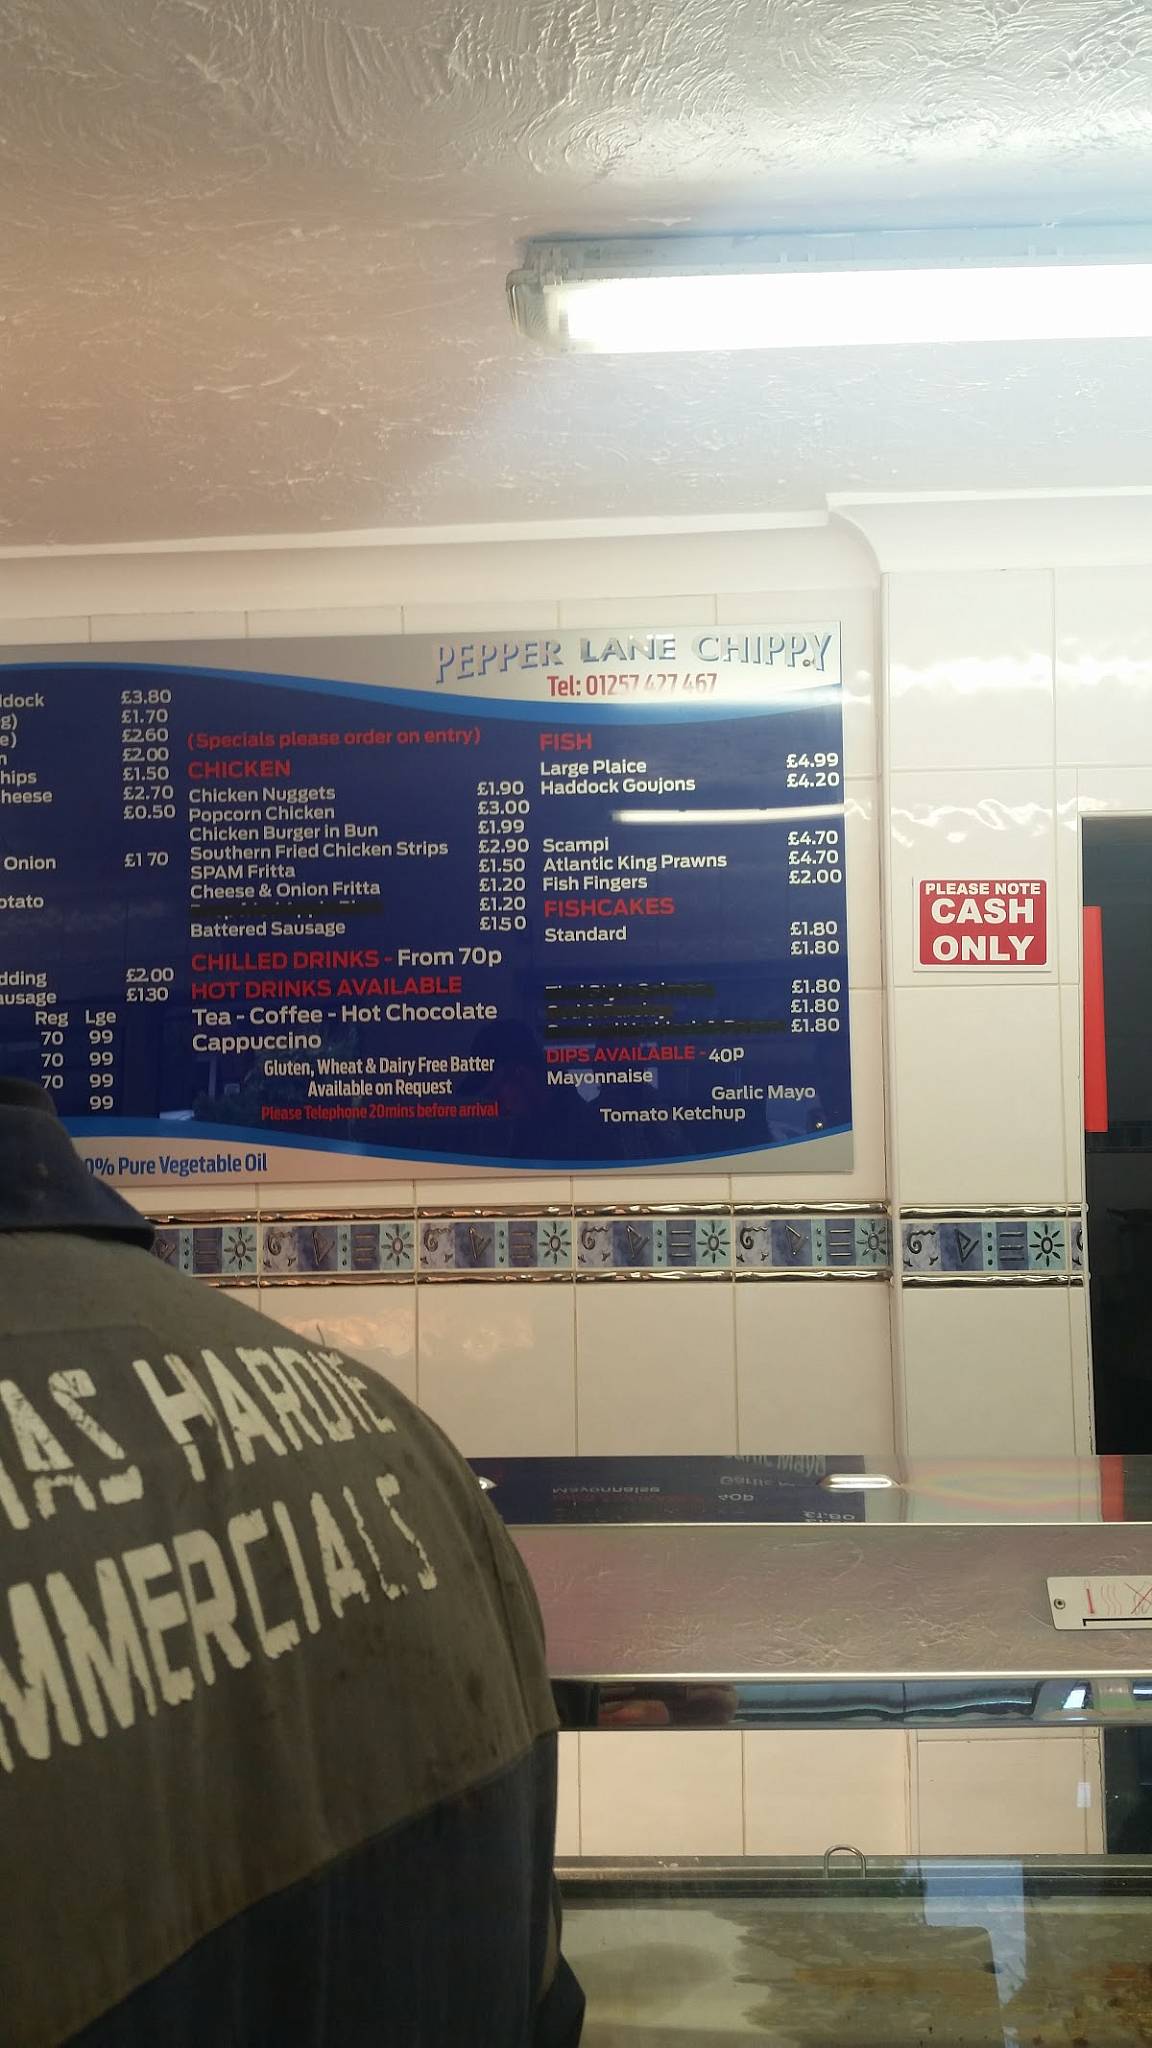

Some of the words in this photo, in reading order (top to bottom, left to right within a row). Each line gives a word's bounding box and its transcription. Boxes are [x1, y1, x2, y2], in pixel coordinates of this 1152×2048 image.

[431, 637, 564, 685] PEPPER
[580, 632, 677, 663] LANE
[546, 675, 581, 697] Tel:
[586, 674, 639, 697] 01257
[0, 693, 45, 708] dock
[121, 689, 172, 704] £3.80
[121, 708, 169, 724] £1.70
[279, 731, 340, 748] please
[344, 730, 392, 745] order
[396, 731, 420, 744] on
[424, 727, 481, 746] entry)
[539, 732, 592, 751] FISH
[122, 747, 169, 762] £2.00
[786, 753, 839, 768] £4.99
[122, 766, 170, 781] £1.50
[187, 760, 292, 779] CHICKEN
[540, 761, 589, 778] Large
[592, 759, 647, 775] Plaice
[540, 779, 619, 795] Haddock
[622, 777, 696, 795] Goujons
[786, 772, 840, 788] £4.20
[123, 785, 174, 800] £2.70
[189, 788, 258, 803] Chicken
[262, 786, 336, 804] Nuggets
[477, 781, 524, 796] £1.90
[123, 804, 176, 820] £0.50
[189, 807, 262, 824] Popcorn
[265, 805, 335, 821] Chicken
[477, 800, 530, 815] £3.00
[189, 827, 259, 842] Chicken
[263, 825, 320, 842] Burger
[324, 824, 340, 838] in
[344, 823, 379, 838] Bun
[478, 819, 525, 835] £1.99
[478, 839, 530, 854] £2.90
[543, 837, 609, 853] Scampi
[787, 831, 838, 846] £4.70
[190, 845, 275, 861] Southern
[276, 843, 319, 858] Fried
[322, 842, 392, 857] Chicken
[396, 840, 449, 859] Strips
[788, 850, 839, 865] £4.70
[4, 856, 57, 870] Onion
[479, 858, 526, 873] £1.50
[543, 856, 614, 872] Atlantic
[617, 855, 657, 872] King
[661, 854, 728, 869] Prawns
[190, 865, 243, 880] SPAM
[248, 863, 296, 878] Fritta
[788, 869, 842, 885] £2.00
[190, 884, 255, 899] Cheese
[258, 883, 273, 898] &
[276, 882, 328, 898] Onion
[332, 880, 381, 896] Fritta
[479, 877, 526, 892] £1.20
[543, 876, 579, 891] Fish
[583, 876, 648, 892] Fingers
[925, 882, 990, 895] PLEASE
[995, 882, 1041, 895] NOTE
[479, 897, 526, 912] £1.20
[543, 897, 676, 918] FISHCAKES
[931, 898, 1034, 924] CASH
[190, 922, 267, 938] Battered
[270, 921, 346, 937] Sausage
[545, 926, 627, 942] Standard
[790, 921, 838, 936] £1.80
[790, 940, 840, 956] £1.80
[932, 935, 1035, 961] ONLY
[191, 952, 288, 972] CHILLED
[293, 949, 380, 969] DRINKS
[398, 949, 454, 967] From
[458, 948, 502, 967] 70p
[126, 967, 174, 983] £2.00
[191, 981, 240, 1000] HOT
[245, 979, 332, 999] DRINKS
[336, 976, 462, 997] AVAILABLE
[791, 979, 841, 994] £1.80
[192, 1008, 231, 1026] Tea
[250, 1006, 323, 1025] Coffee
[341, 1004, 381, 1023] Hot
[386, 1002, 498, 1021] Chocolate
[790, 998, 840, 1014] £1.80
[35, 1011, 69, 1027] Reg
[85, 1009, 117, 1026] Lge
[791, 1018, 840, 1033] £1.80
[41, 1031, 64, 1046] 70
[89, 1030, 114, 1045] 99
[192, 1032, 322, 1054] Cappuccino
[41, 1053, 64, 1068] 70
[89, 1052, 114, 1067] 99
[546, 1048, 590, 1065] DIPS
[594, 1045, 695, 1062] AVAILABLE
[264, 1059, 314, 1077] Gluten,
[317, 1058, 363, 1074] Wheat
[365, 1058, 376, 1073] &
[379, 1057, 415, 1076] Dairy
[418, 1057, 447, 1072] Free
[450, 1056, 495, 1072] Batter
[41, 1075, 64, 1090] 70
[89, 1074, 114, 1089] 99
[547, 1069, 653, 1088] Mayonnaise
[307, 1080, 373, 1098] Available
[375, 1084, 393, 1096] on
[396, 1079, 452, 1098] Request
[711, 1085, 763, 1100] Garlic
[768, 1085, 816, 1101] Mayo
[89, 1095, 114, 1111] 99
[261, 1104, 301, 1121] Please
[304, 1104, 367, 1121] Telephone
[369, 1103, 415, 1119] 20mins
[416, 1103, 457, 1118] before
[459, 1102, 499, 1117] arrival
[600, 1108, 668, 1123] Tomato
[672, 1105, 746, 1122] Ketchup
[118, 1157, 156, 1175] Pure
[159, 1154, 242, 1177] Vegetable
[245, 1153, 267, 1172] Oil
[0, 1368, 144, 1530] AS
